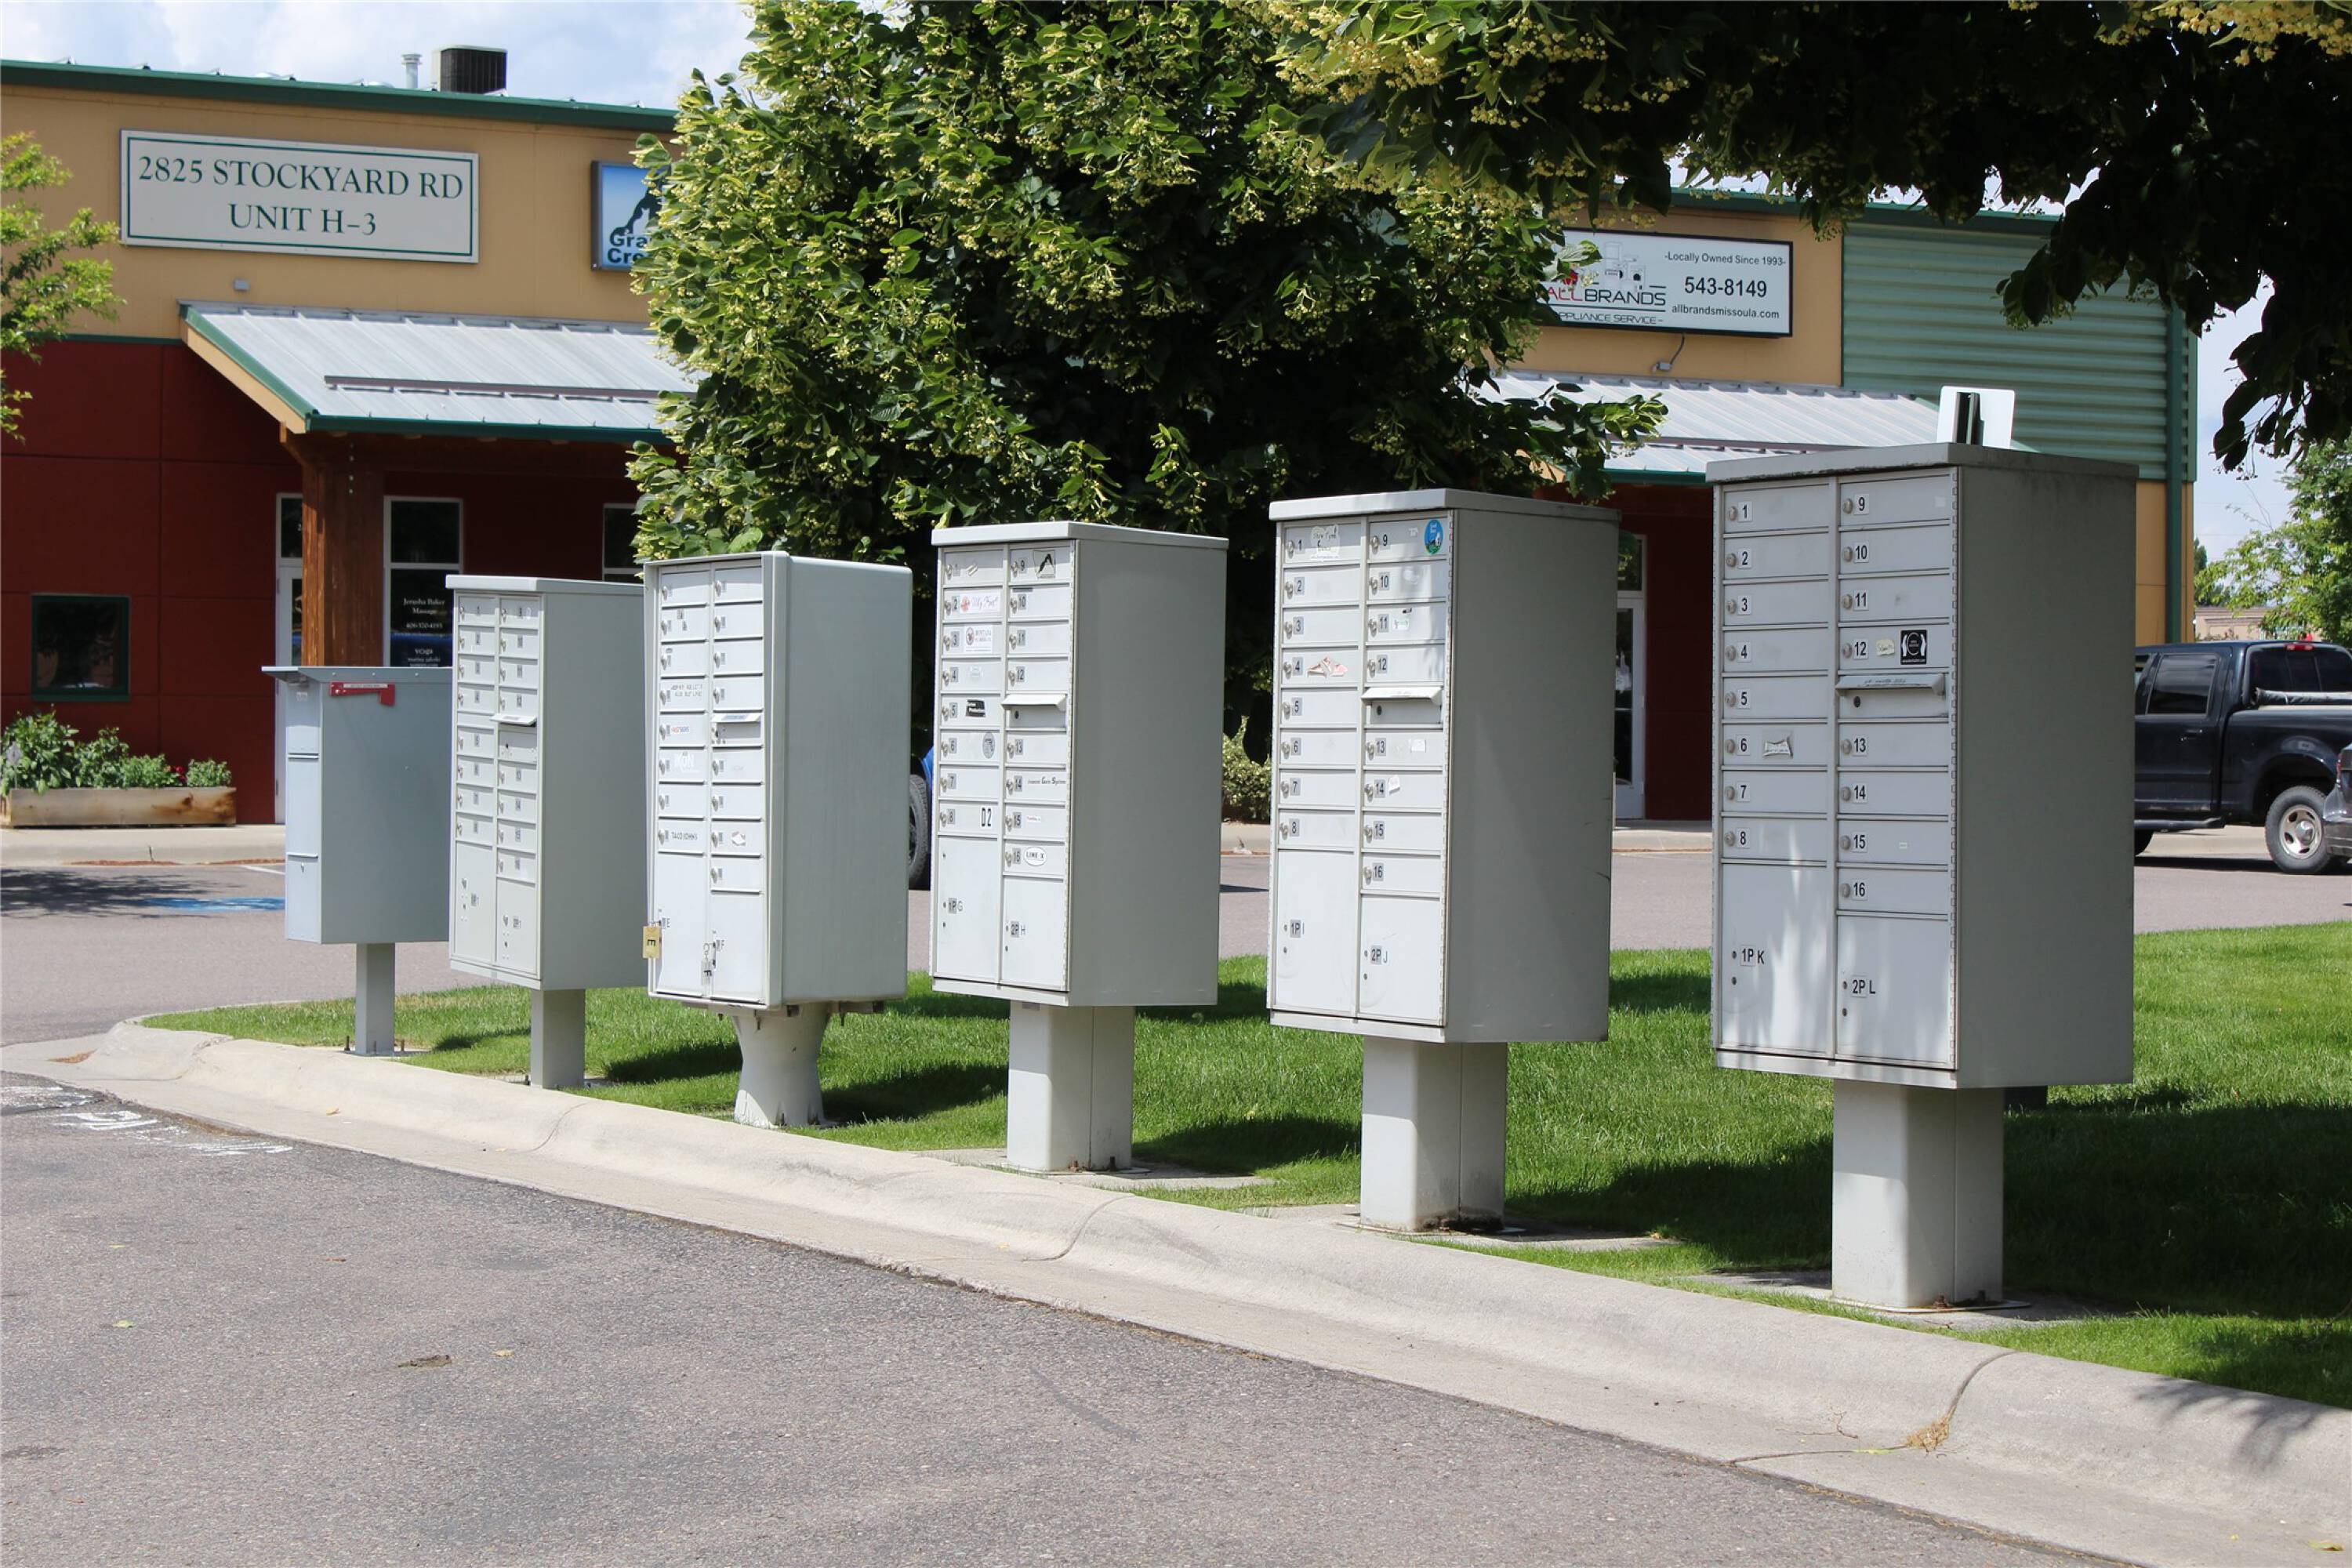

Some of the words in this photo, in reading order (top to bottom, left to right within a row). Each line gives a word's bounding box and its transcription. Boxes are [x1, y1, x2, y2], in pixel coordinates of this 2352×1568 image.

[139, 156, 202, 183] 2825
[213, 159, 409, 195] STOCKYARD
[419, 172, 463, 199] RD
[227, 203, 312, 230] UNIT
[321, 208, 376, 235] H-3
[610, 230, 652, 248] Gra
[1702, 252, 1733, 264] Owned
[1736, 255, 1759, 265] Since
[1685, 276, 1767, 298] 543-8149
[1559, 311, 1610, 322] PPLIANCE
[1671, 303, 1780, 319] allbrandsmissoula.com
[1743, 504, 1748, 518] 1
[1859, 496, 1865, 512] 9
[1298, 539, 1302, 551] 1
[1382, 534, 1388, 546] 9
[1742, 551, 1748, 566] 2
[1856, 545, 1867, 560] 10
[1021, 560, 1025, 571] 9
[1297, 580, 1302, 592] 2
[1380, 575, 1389, 587] 10
[953, 598, 958, 610] 2
[1741, 597, 1748, 612] 3
[1856, 593, 1867, 607] 11
[1296, 620, 1301, 632] 3
[1379, 618, 1388, 630] 11
[1740, 644, 1748, 659] 4
[1854, 641, 1867, 656] 12
[1294, 661, 1301, 672] 4
[1377, 658, 1387, 670] 12
[1017, 669, 1024, 681] 12
[1741, 691, 1748, 706] 5
[1294, 701, 1299, 713] 5
[1294, 741, 1299, 753] 6
[1377, 741, 1385, 753] 13
[1740, 738, 1747, 753] 6
[1853, 739, 1866, 753] 13
[1293, 781, 1298, 793] 7
[1375, 782, 1384, 794] 14
[1740, 785, 1747, 799] 7
[1854, 786, 1866, 800] 14
[1291, 822, 1297, 833] 8
[1374, 824, 1384, 837] 15
[1740, 831, 1746, 845] 8
[1853, 834, 1865, 849] 15
[1374, 866, 1382, 878] 16
[1853, 882, 1865, 897] 16
[1742, 948, 1754, 963] 1P
[1852, 979, 1865, 994] 2P
